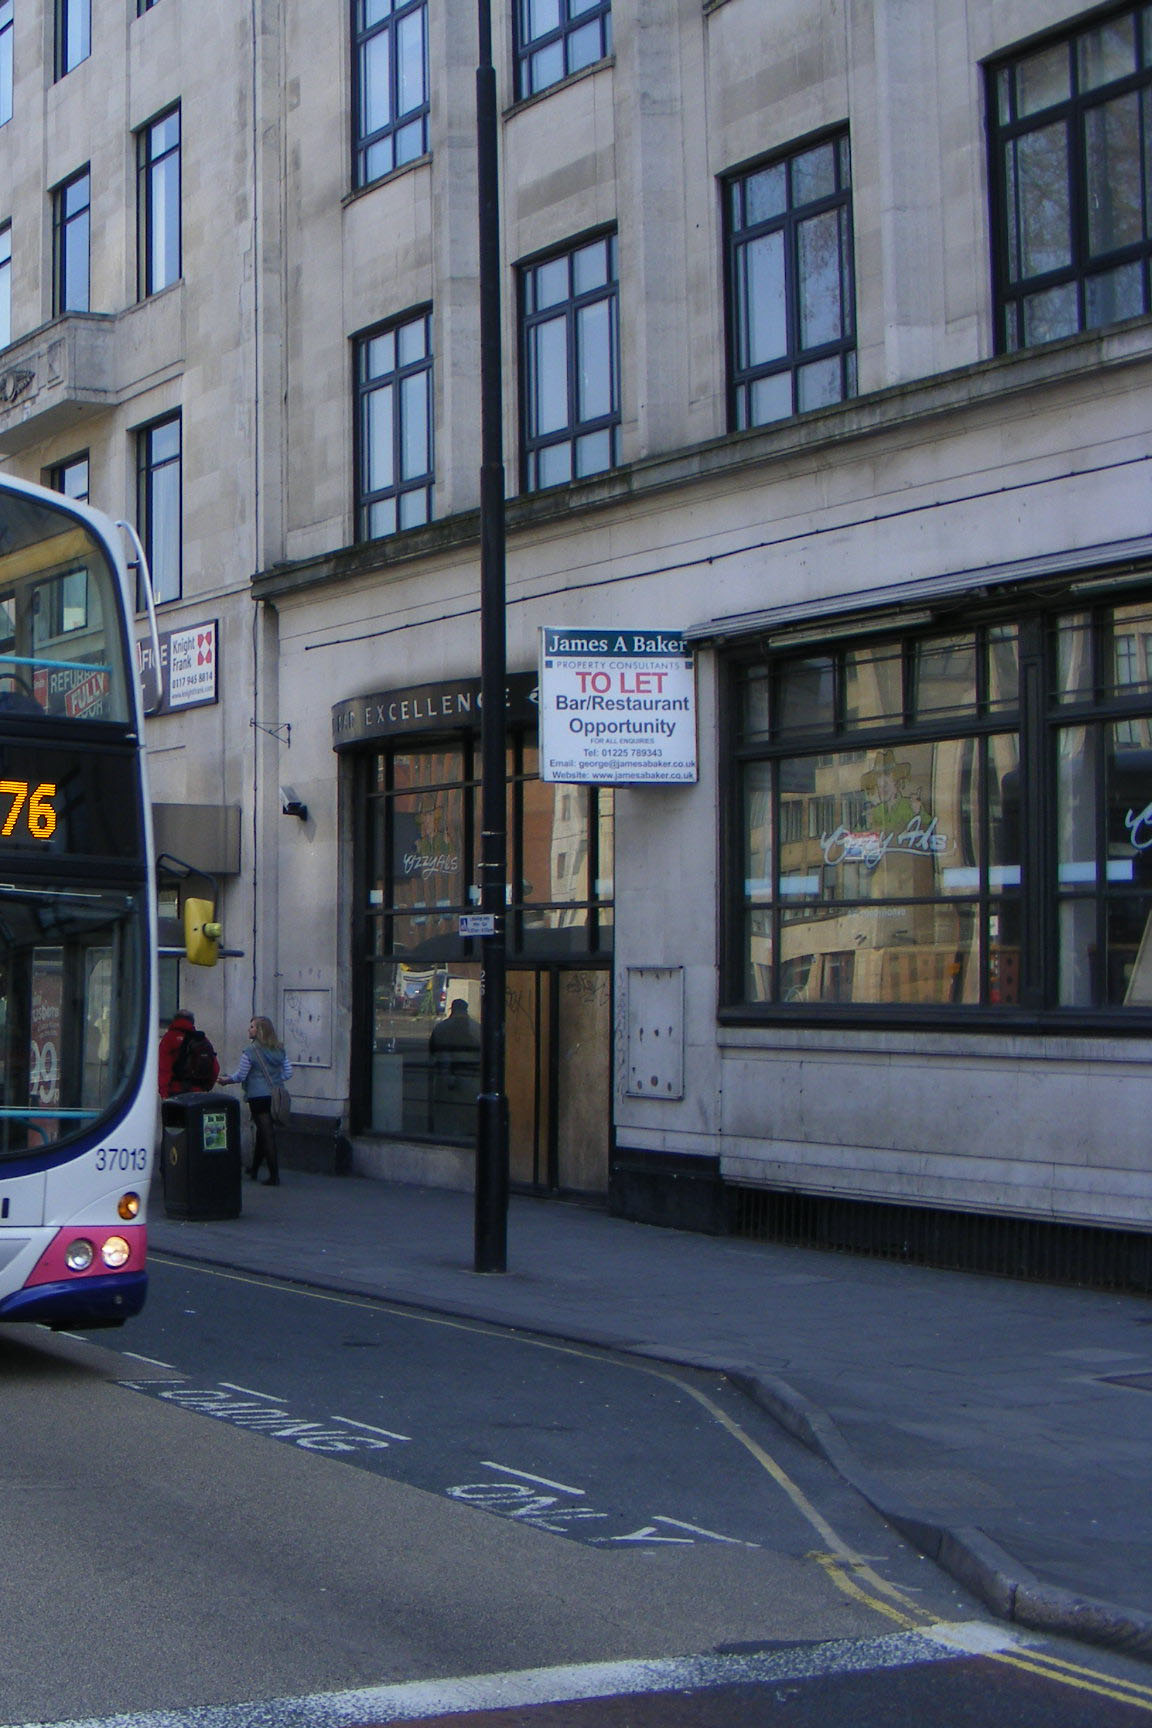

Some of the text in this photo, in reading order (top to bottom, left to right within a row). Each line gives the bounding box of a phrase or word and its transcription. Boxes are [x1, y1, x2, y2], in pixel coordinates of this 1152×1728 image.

[172, 634, 195, 656] Knight
[549, 635, 688, 652] James A Baker
[172, 655, 192, 672] Frank
[556, 661, 680, 670] PROPERTY CONSULTANTS
[575, 672, 668, 694] TO LET
[71, 672, 105, 715] FULLY
[556, 695, 689, 711] Bar/Restaurant
[569, 718, 676, 737] Opportunity
[584, 748, 663, 757] Tel: 01225 789343
[550, 759, 695, 769] Email: george@jamesabaker.co.uk
[552, 771, 693, 781] Website: www.jamesabaker.co.uk
[0, 780, 56, 839] 76
[95, 1148, 147, 1172] 37013
[117, 1380, 389, 1451] LOADING
[446, 1483, 695, 1543] ONLY
